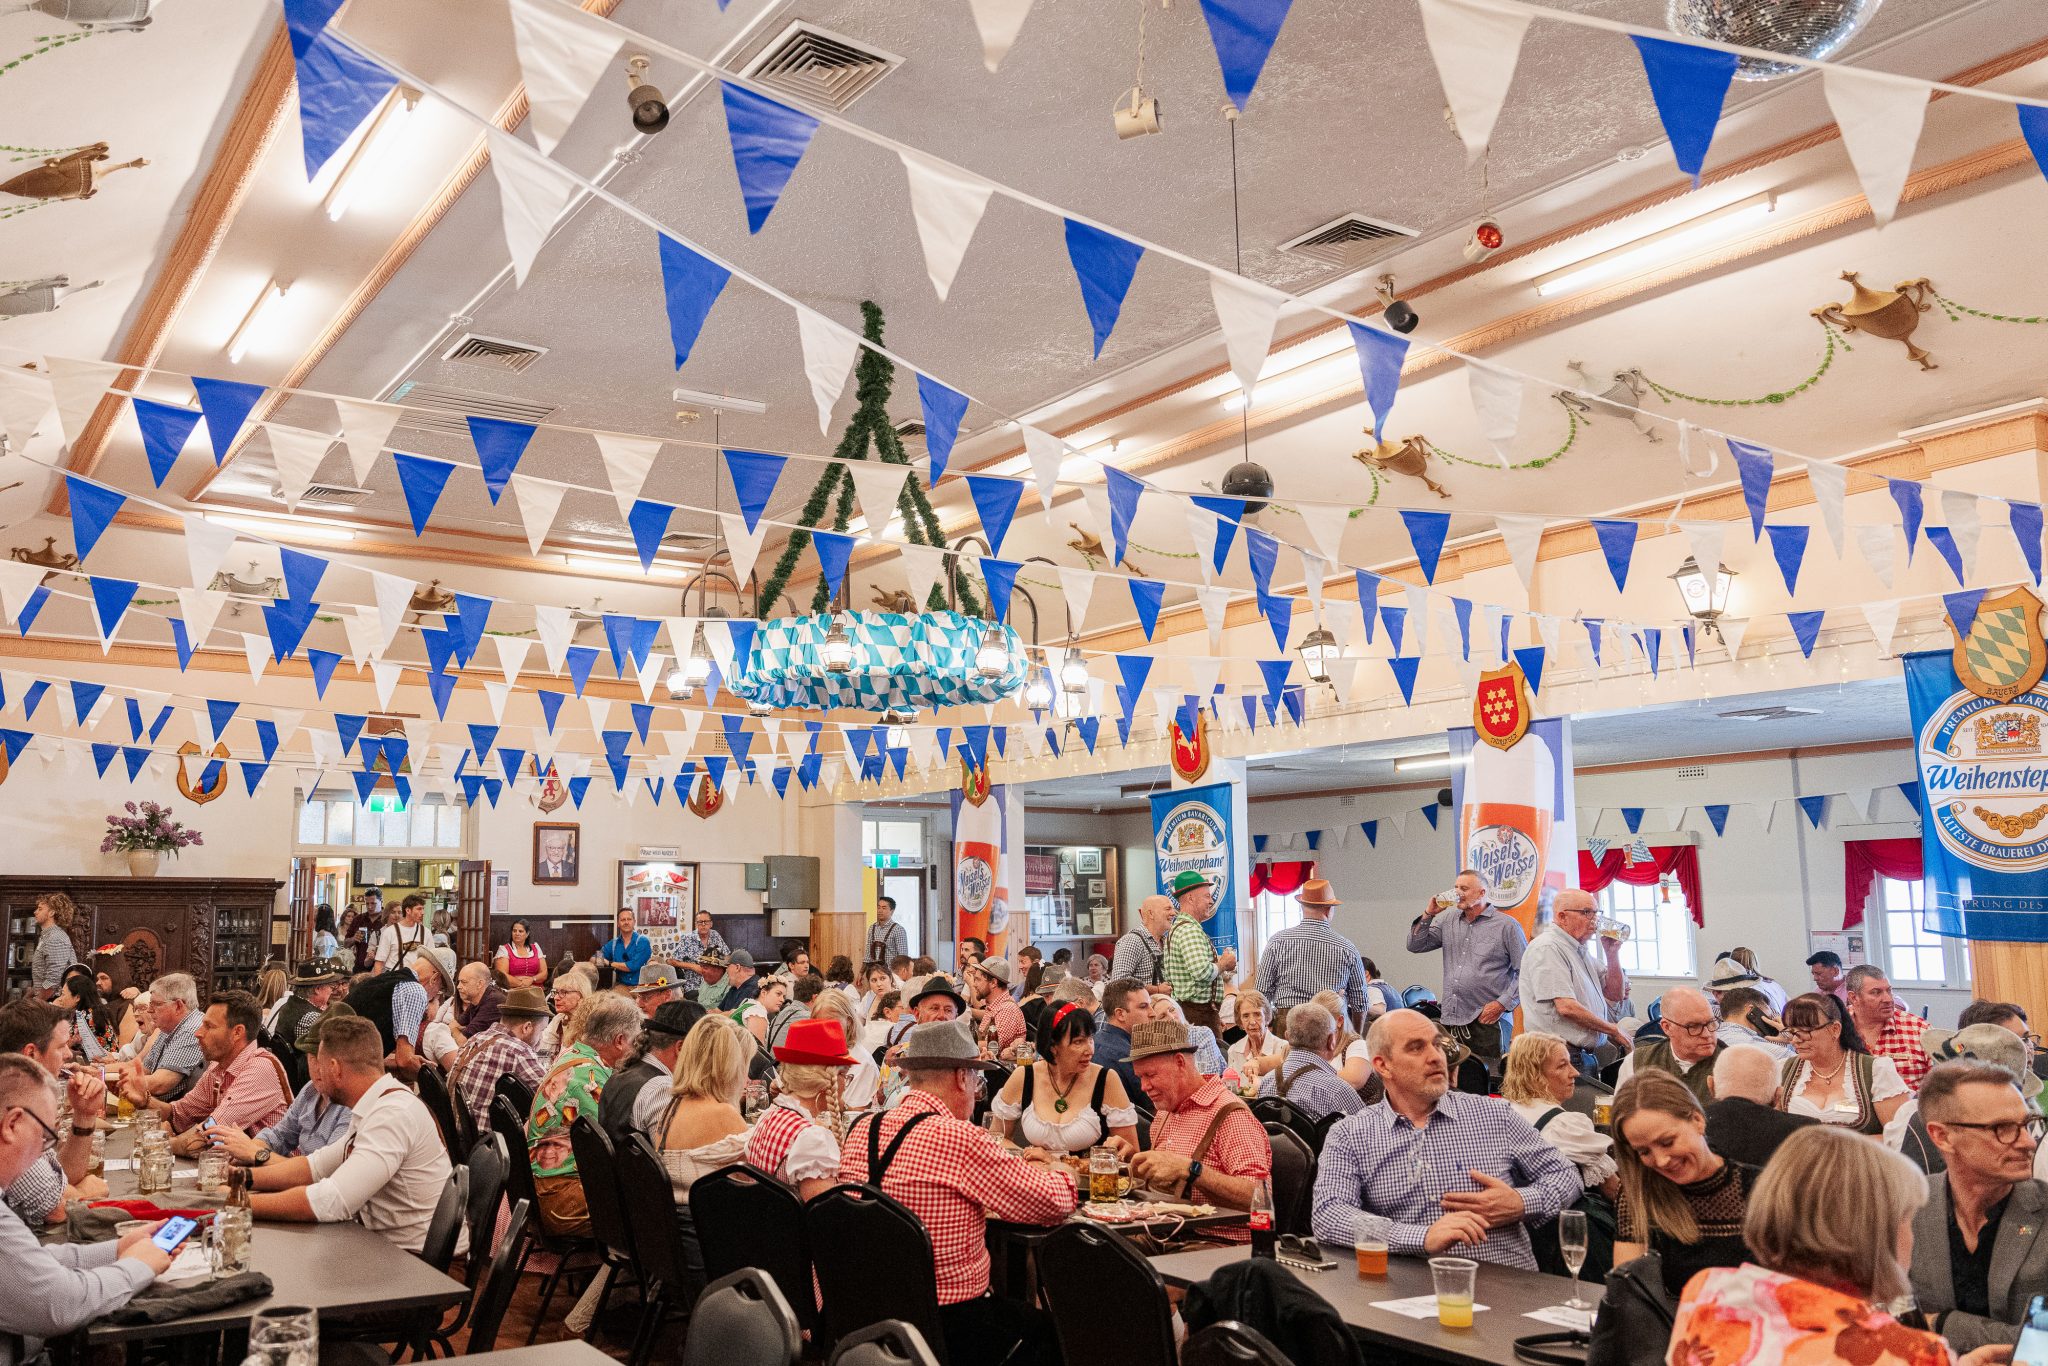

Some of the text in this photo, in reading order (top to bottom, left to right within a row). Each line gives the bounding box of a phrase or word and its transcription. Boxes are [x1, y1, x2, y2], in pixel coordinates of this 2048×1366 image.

[1942, 697, 1996, 735] PREMIUM
[1164, 813, 1187, 839] PREMIUM
[1941, 815, 1979, 849] ÄLTESTE
[1980, 844, 2034, 858] BRAUEREI
[1473, 836, 1521, 871] Maisel's
[1489, 854, 1534, 887] Weisse
[2019, 900, 2044, 909] DES
